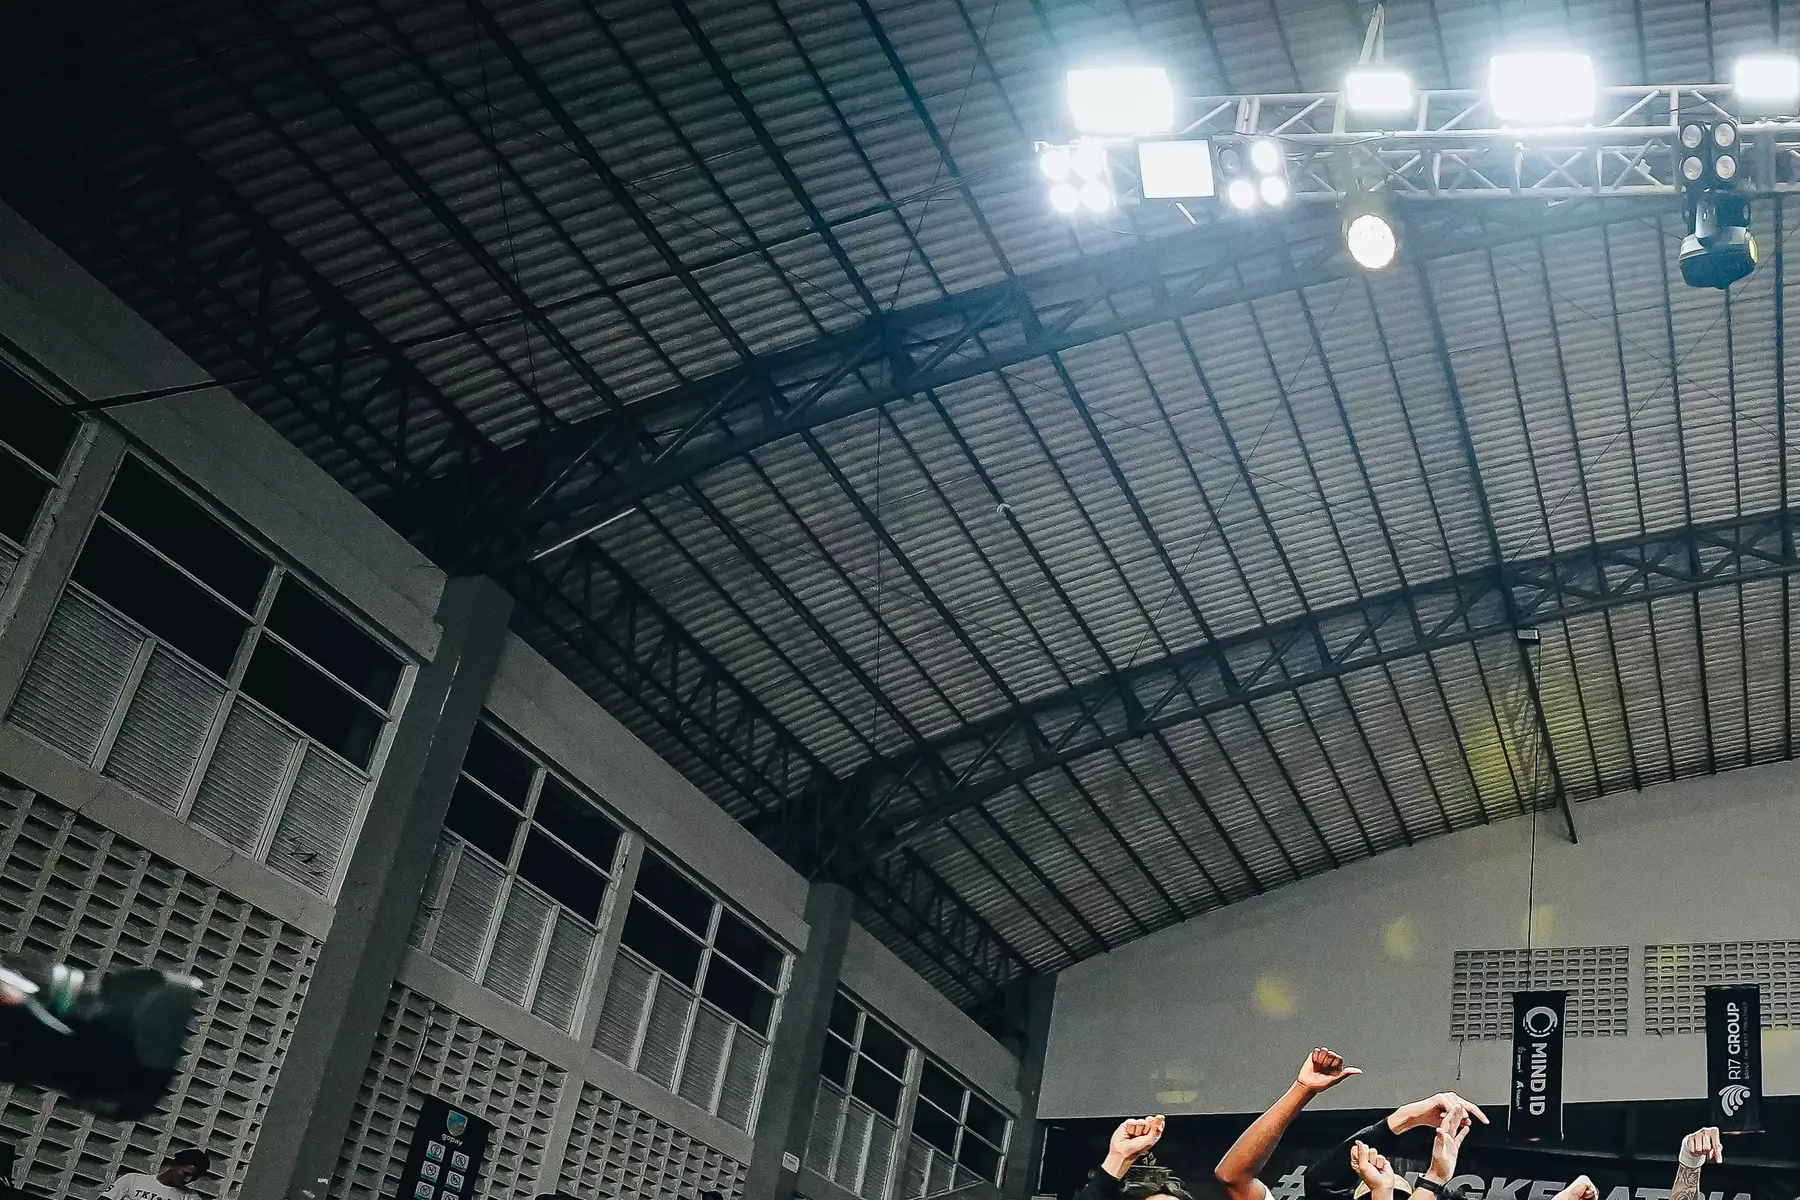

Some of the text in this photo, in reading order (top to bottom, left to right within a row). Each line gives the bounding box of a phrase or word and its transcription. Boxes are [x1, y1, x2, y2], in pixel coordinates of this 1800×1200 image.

[1529, 1042, 1548, 1116] MIND ID
[1727, 1002, 1741, 1080] R17 GROUP
